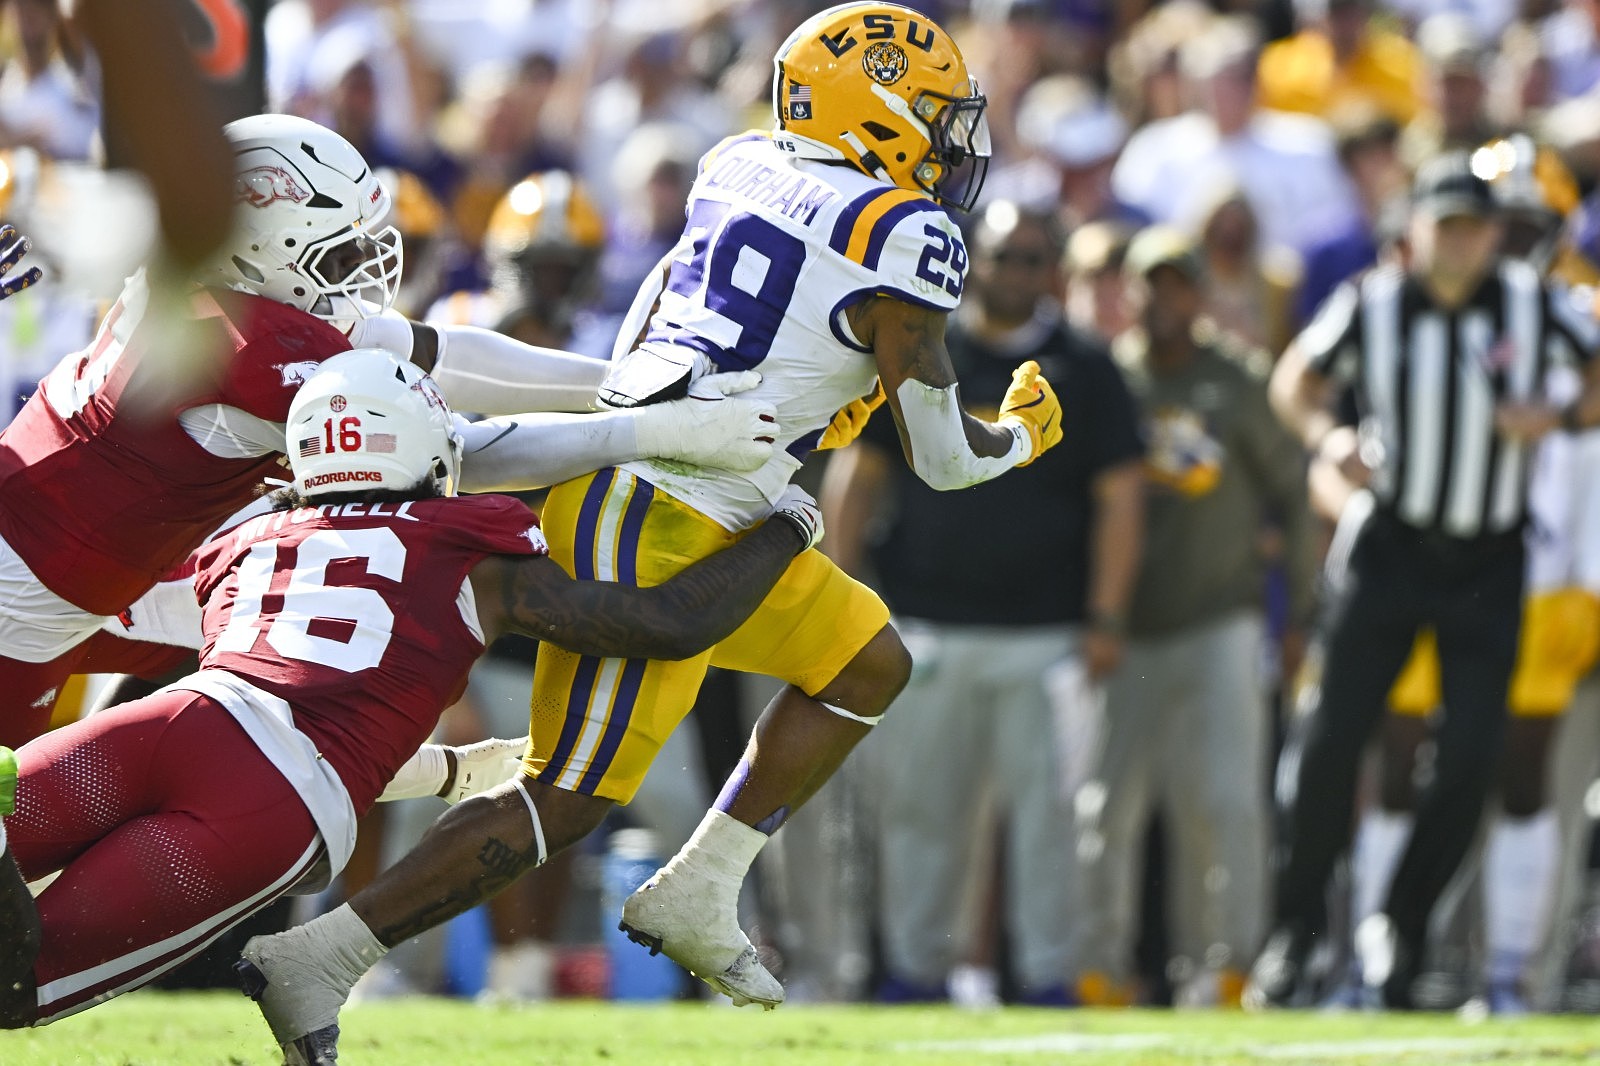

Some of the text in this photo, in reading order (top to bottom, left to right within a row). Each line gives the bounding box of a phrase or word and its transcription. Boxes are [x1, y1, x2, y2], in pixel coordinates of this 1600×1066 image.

[819, 14, 935, 58] LSU
[705, 156, 836, 227] DURHAM
[645, 198, 806, 373] 29
[915, 222, 967, 299] 29
[323, 416, 362, 454] 16
[303, 471, 383, 490] RAZORBACKS
[212, 526, 407, 674] 16
